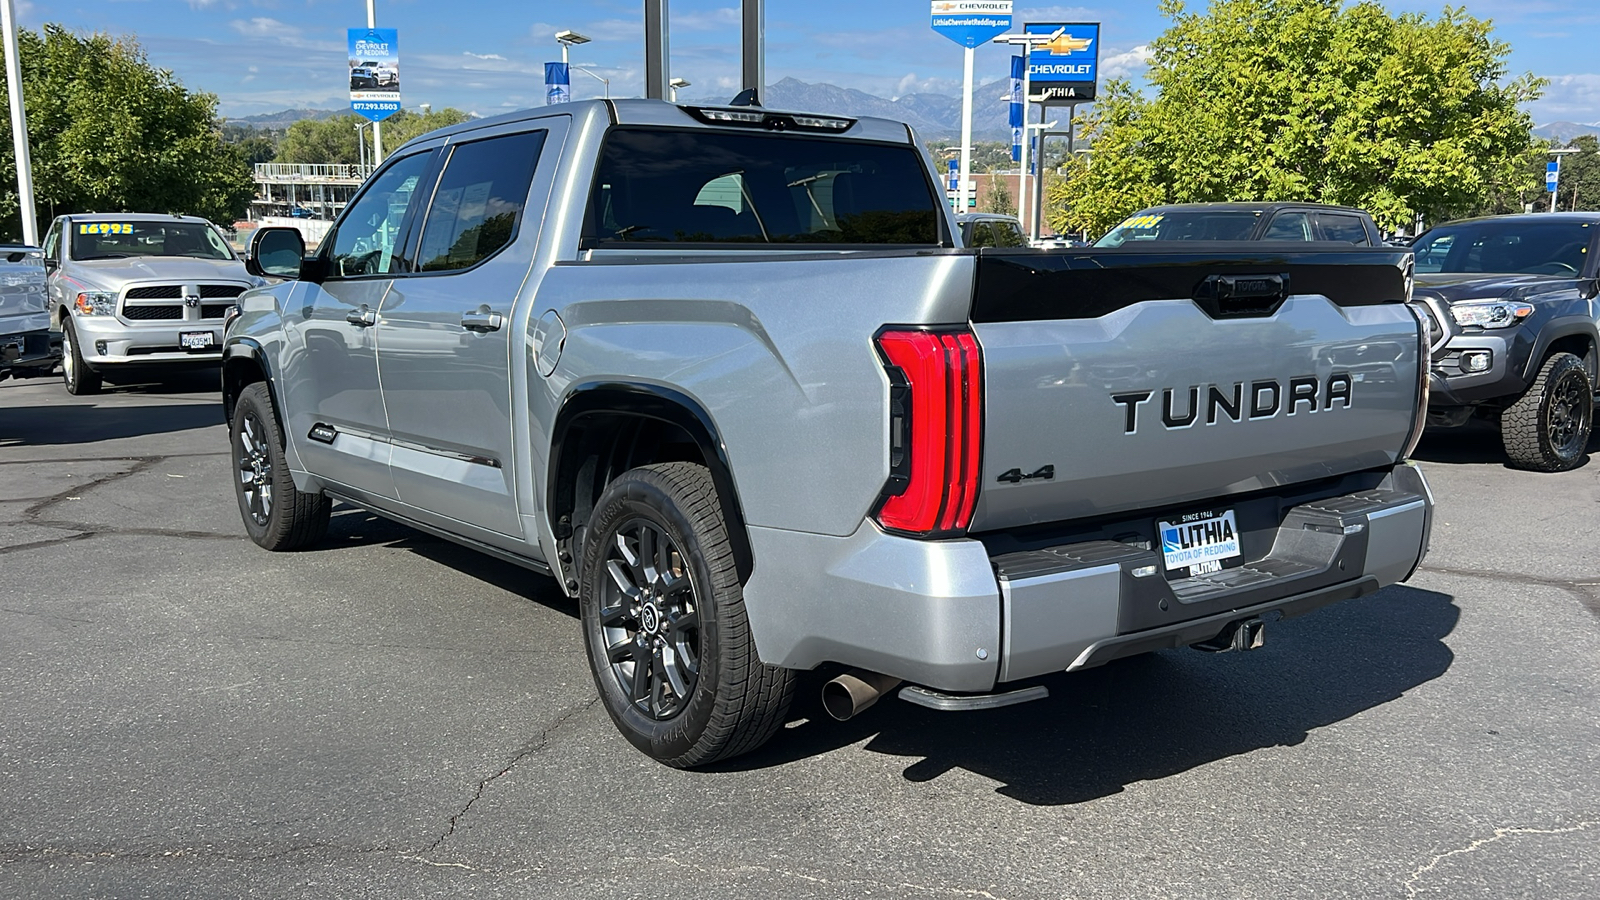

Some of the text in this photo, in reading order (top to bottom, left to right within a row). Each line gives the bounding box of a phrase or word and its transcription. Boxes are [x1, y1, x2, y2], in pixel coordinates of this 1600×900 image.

[933, 18, 1009, 27] LithiaChevroletRedding.com
[1029, 64, 1092, 74] CHEVROLET
[80, 223, 133, 234] 16995
[1236, 281, 1267, 291] TOYOTA
[1109, 371, 1353, 435] TUNDRA
[1182, 510, 1213, 522] SINCE 1946
[1178, 519, 1234, 550] LITHIA
[1165, 542, 1236, 564] TOYOTA OF REDDING
[1198, 560, 1222, 575] LITHIA
